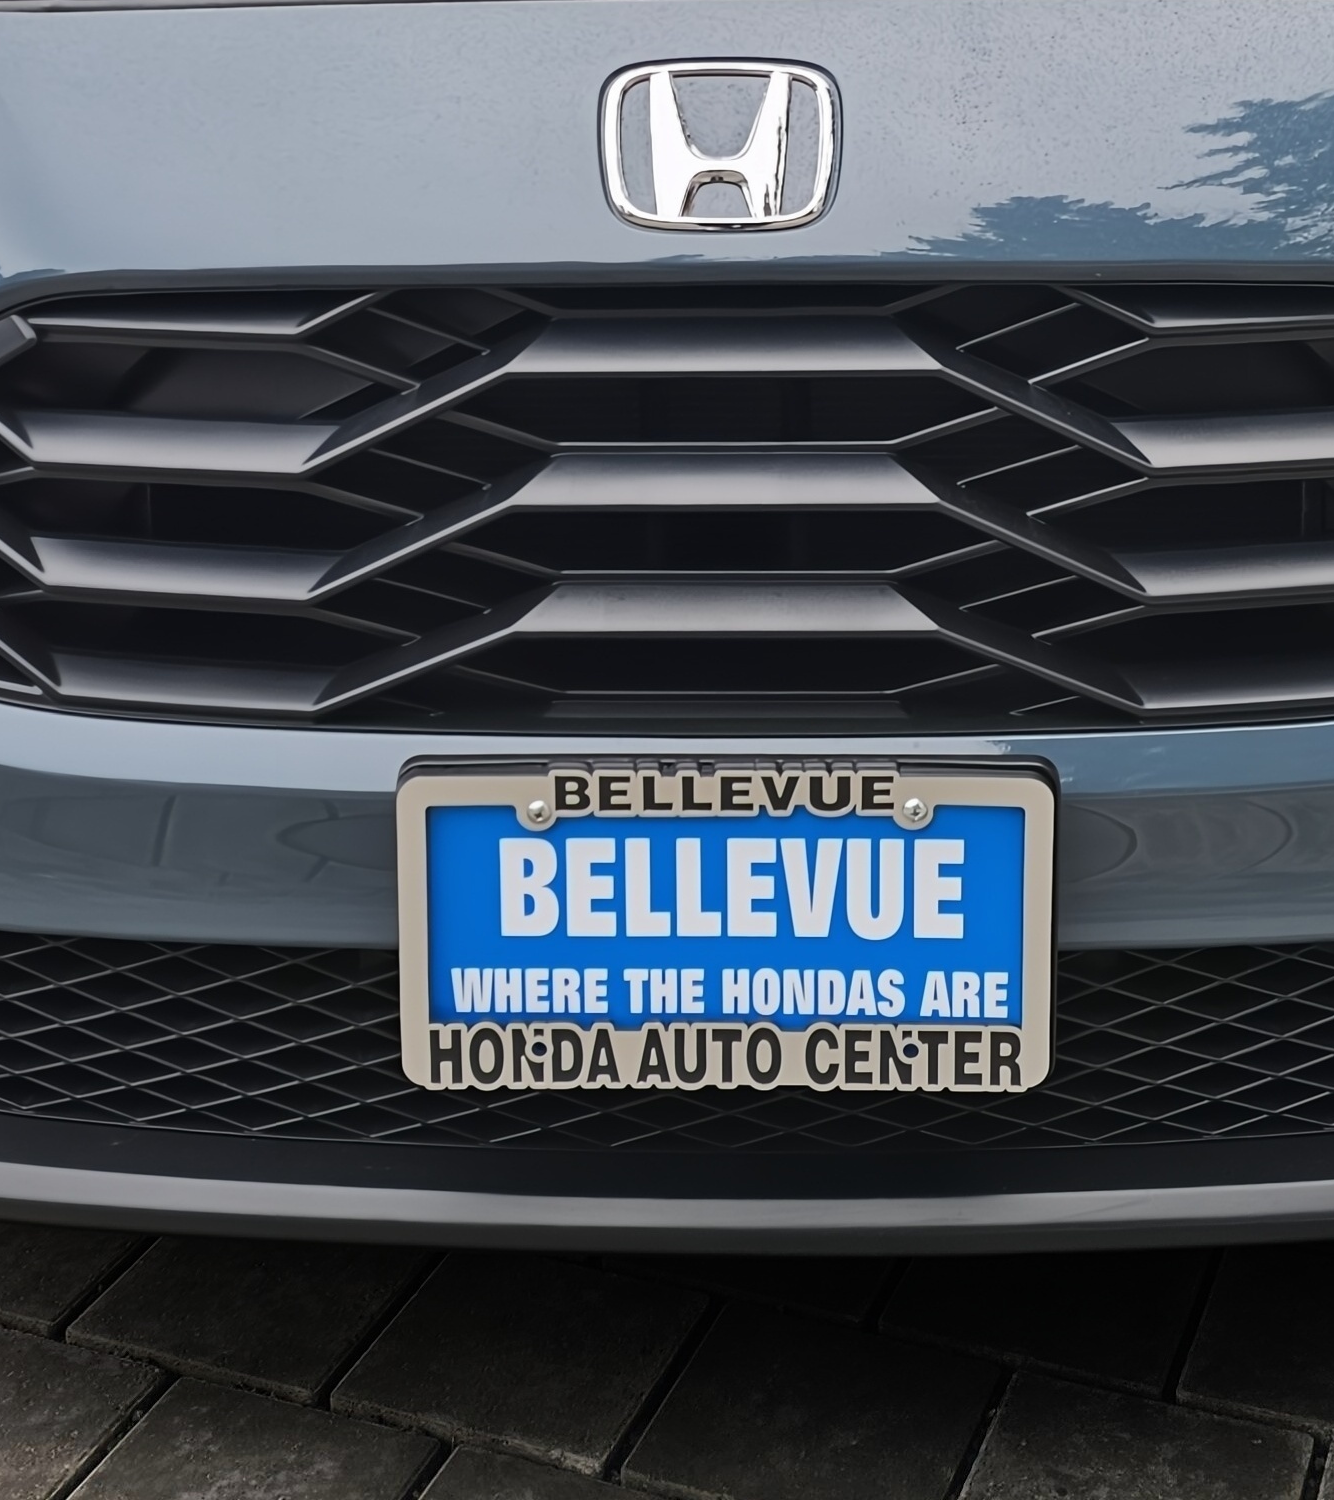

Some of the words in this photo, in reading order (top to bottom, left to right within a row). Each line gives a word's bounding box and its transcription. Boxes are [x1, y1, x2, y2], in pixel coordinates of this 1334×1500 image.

[552, 774, 896, 813] BELLEVUE
[498, 837, 965, 940] BELLEVUE
[451, 967, 609, 1014] WHERE
[623, 968, 705, 1014] THE
[721, 968, 905, 1018] HONDAS
[919, 972, 1009, 1018] ARE
[428, 1027, 620, 1084] HONDA
[637, 1027, 783, 1084] AUTO
[804, 1028, 1023, 1086] CENTER
